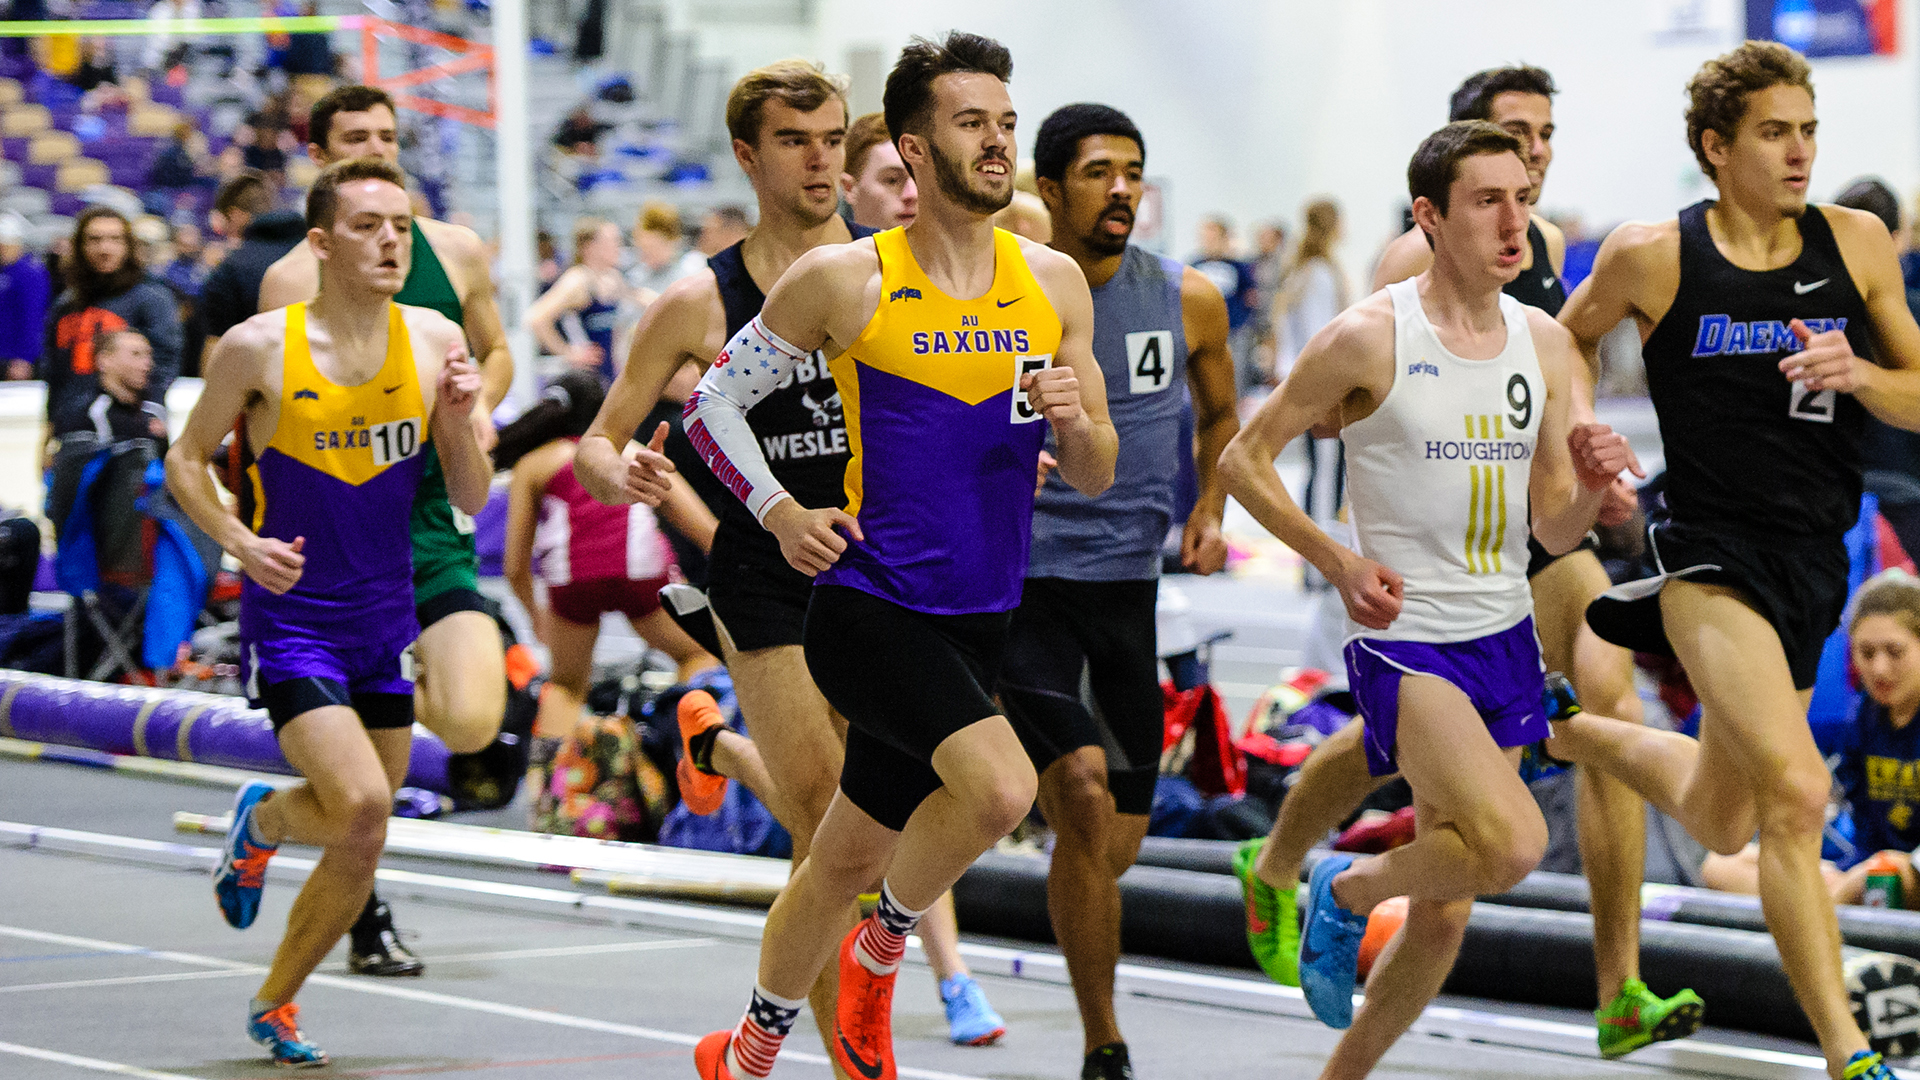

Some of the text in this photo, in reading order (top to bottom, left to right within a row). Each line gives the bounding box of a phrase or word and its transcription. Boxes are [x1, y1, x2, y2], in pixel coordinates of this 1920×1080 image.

[961, 315, 979, 326] AU
[912, 329, 1030, 355] SAXONS
[1136, 337, 1165, 386] 4
[1016, 359, 1046, 418] 5
[1507, 372, 1532, 430] 9
[314, 429, 370, 450] SAXO
[376, 421, 415, 462] 10
[763, 427, 847, 460] WESLE
